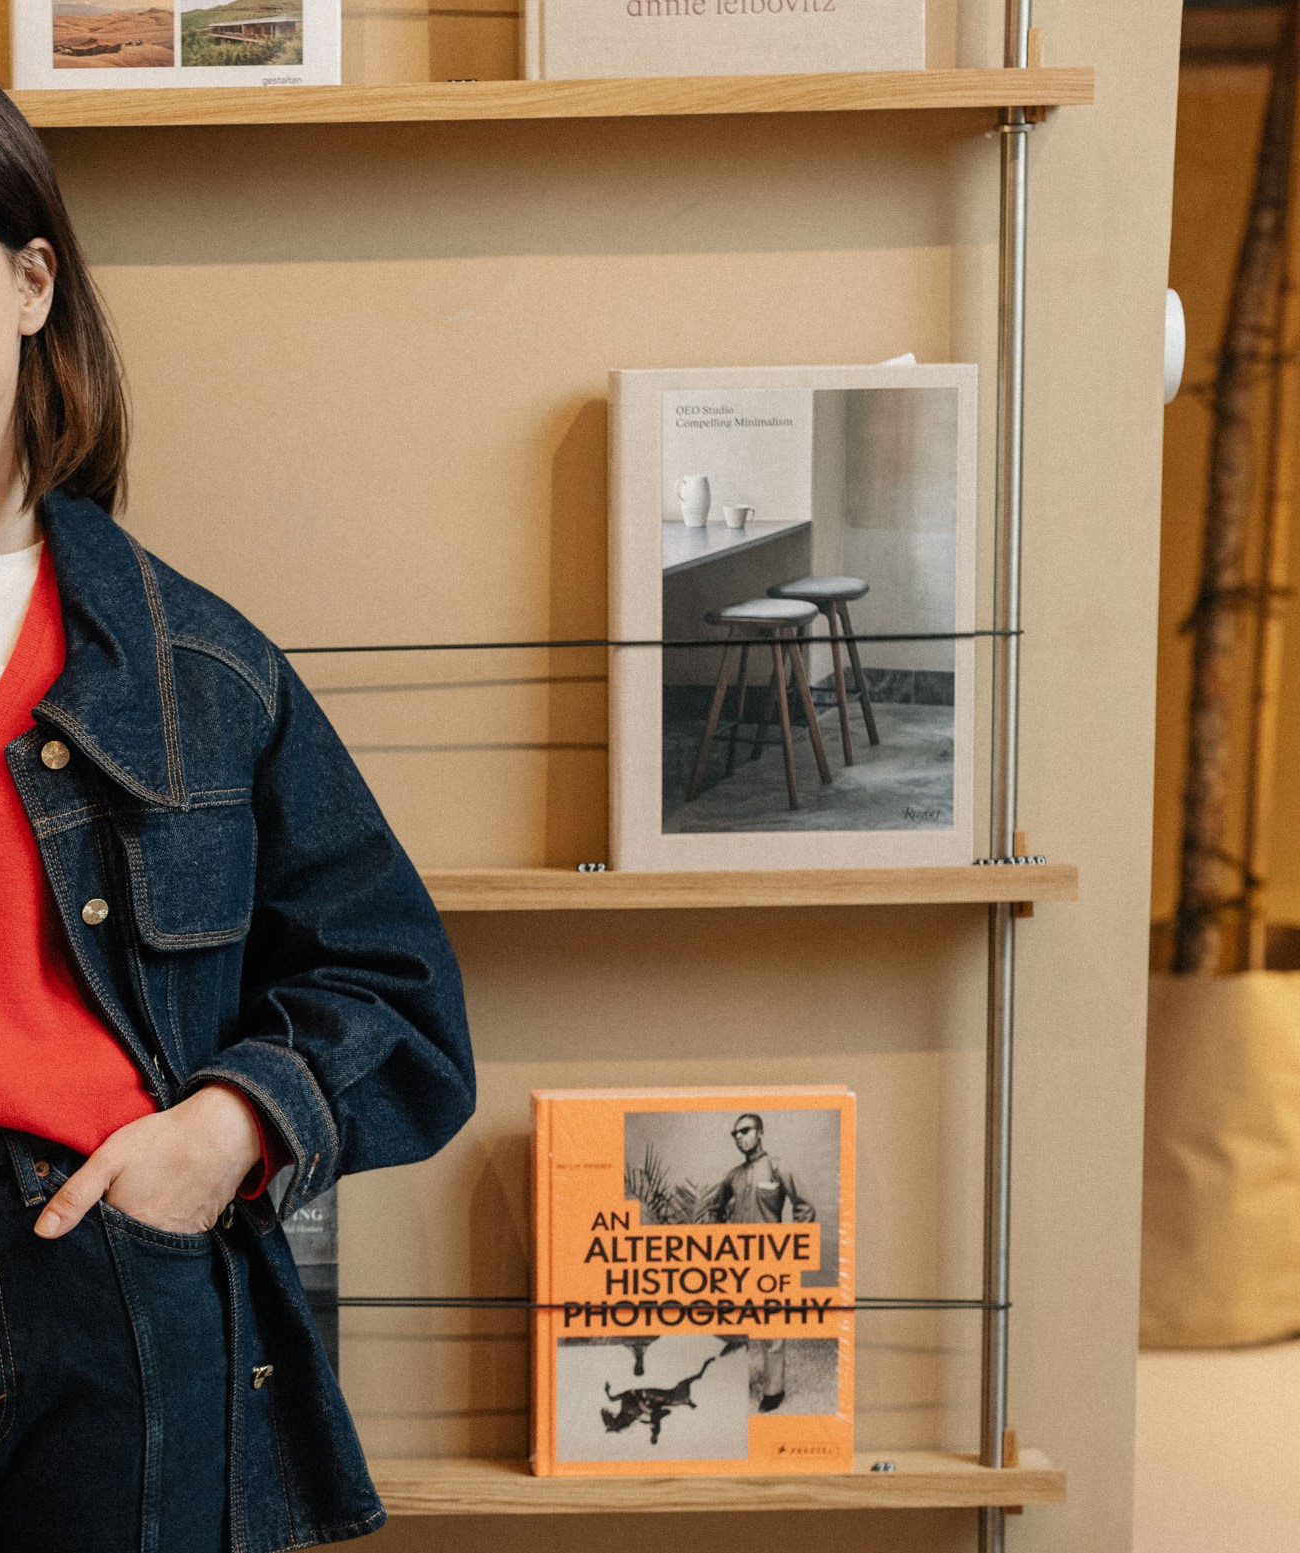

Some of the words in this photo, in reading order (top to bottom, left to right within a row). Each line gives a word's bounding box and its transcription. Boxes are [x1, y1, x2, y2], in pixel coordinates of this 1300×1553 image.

[702, 403, 734, 416] Studio
[675, 418, 732, 429] Compelling
[734, 416, 794, 427] Minimalism
[591, 1211, 630, 1232] AN
[584, 1233, 810, 1264] ALTERNATIVE
[606, 1266, 751, 1296] HISTORY
[757, 1273, 792, 1294] OF
[563, 1297, 833, 1328] PHOTOGRAPHY
